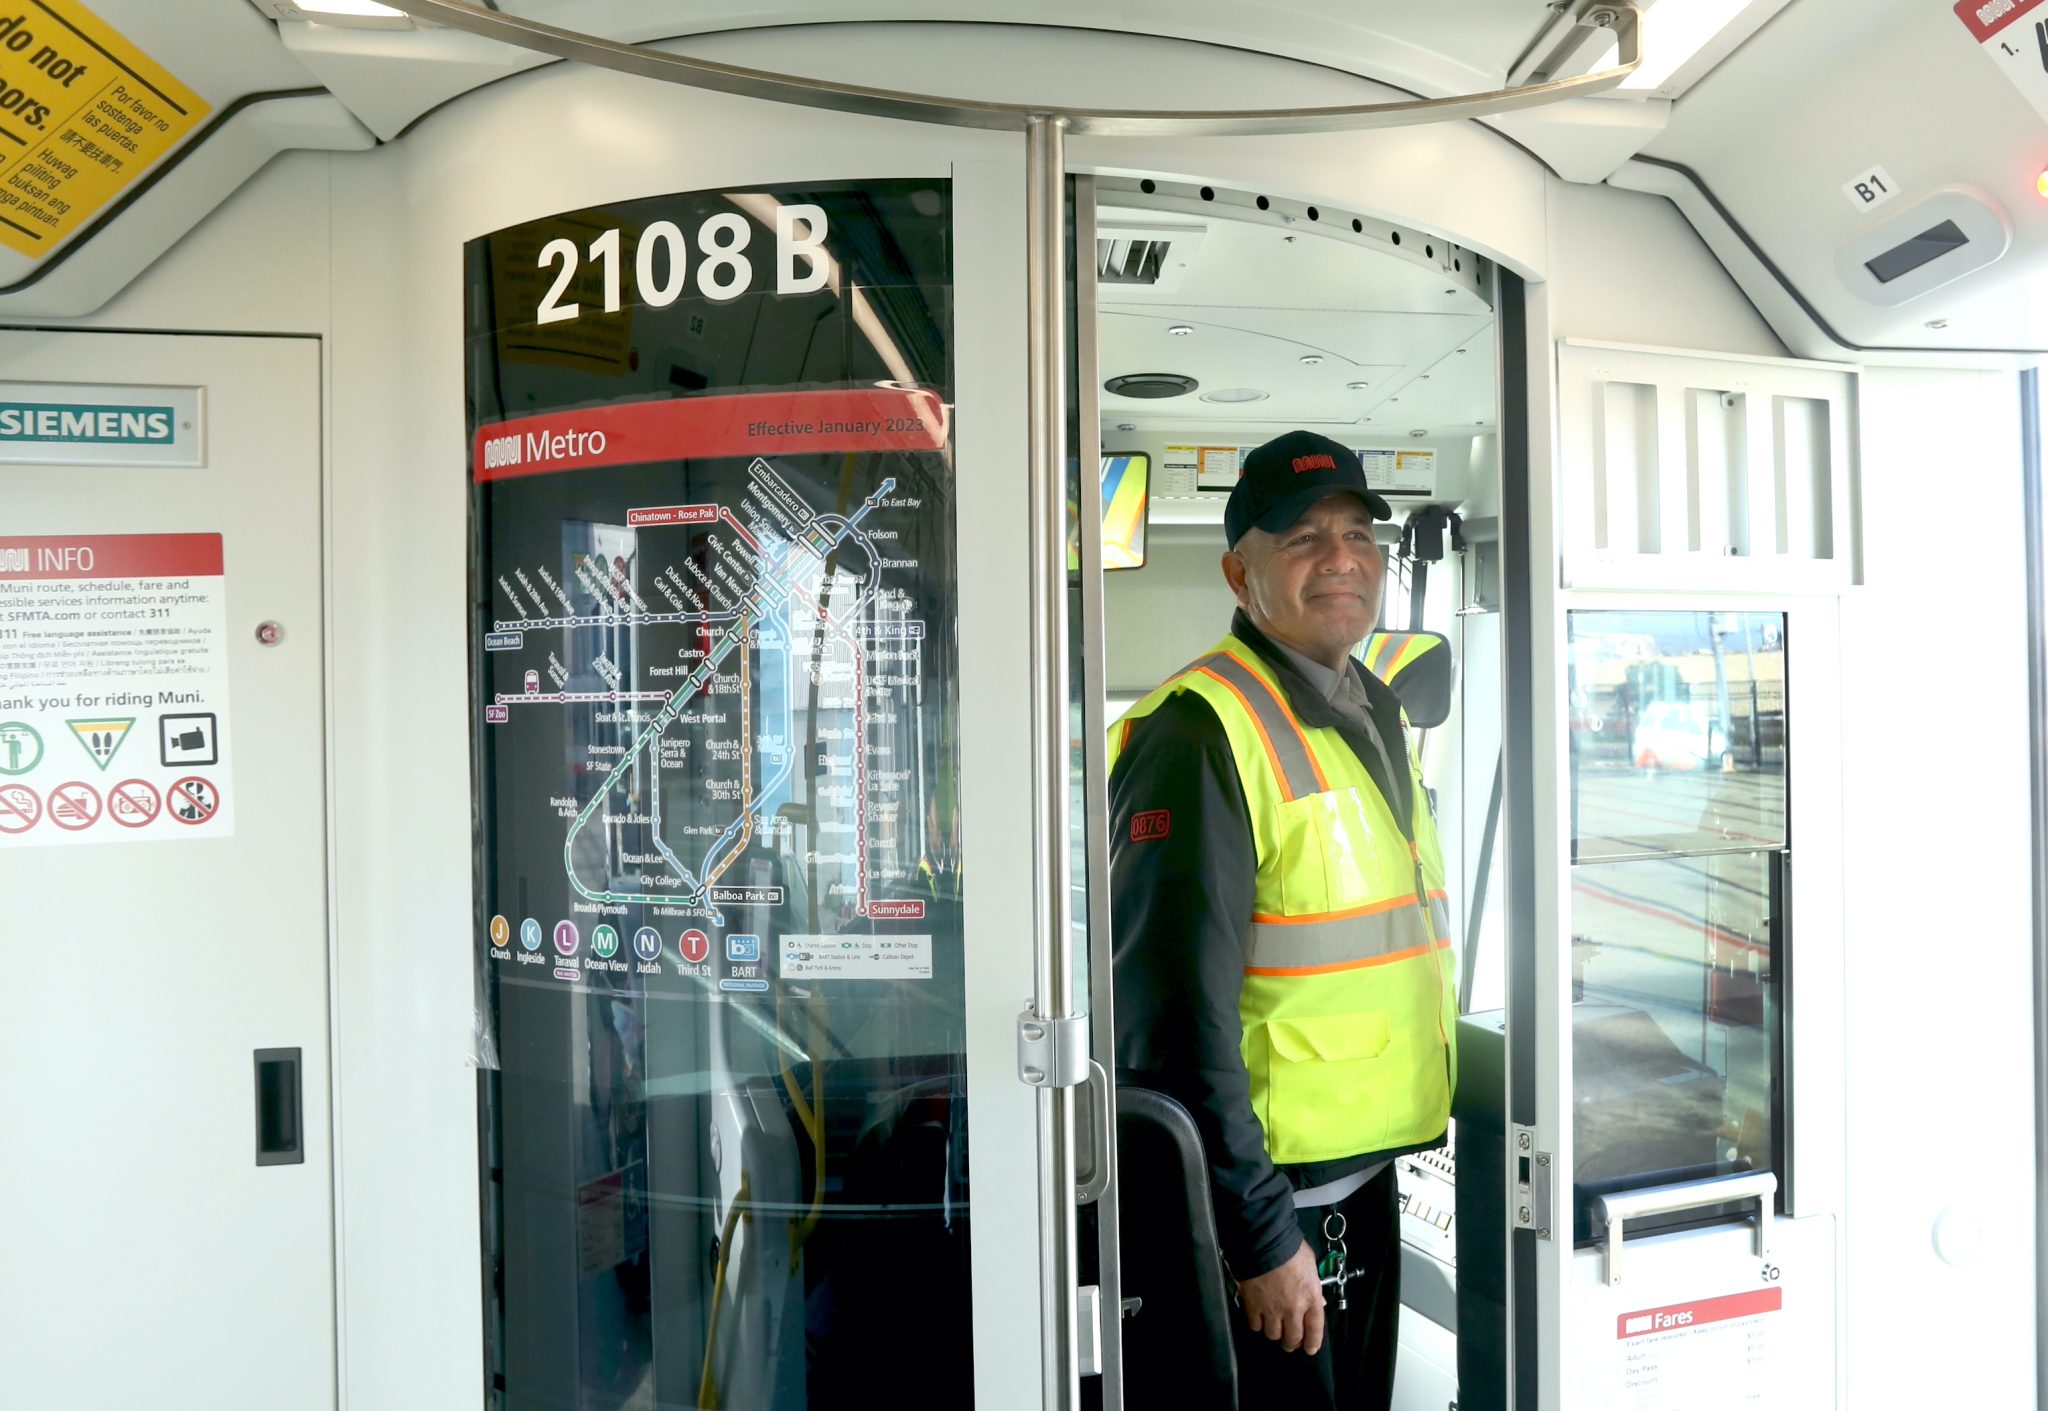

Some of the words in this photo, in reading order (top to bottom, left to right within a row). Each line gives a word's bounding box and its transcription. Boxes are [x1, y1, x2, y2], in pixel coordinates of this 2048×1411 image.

[2001, 42, 2019, 56] 1.
[28, 45, 88, 88] not
[111, 85, 133, 104] Por
[129, 99, 158, 122] favor
[153, 119, 170, 132] no
[96, 100, 143, 135] sostenga
[82, 110, 101, 128] las
[96, 123, 139, 154] puertas.
[37, 148, 78, 179] Huwag
[20, 163, 61, 190] piliting
[8, 173, 50, 202] buksan
[47, 198, 71, 215] ang
[1854, 174, 1888, 203] B1
[15, 202, 59, 228] pintuan.
[536, 212, 753, 325] 2108
[776, 203, 830, 295] B
[0, 410, 169, 438] SIEMENS
[748, 421, 813, 437] Effective
[817, 419, 881, 435] January
[885, 418, 924, 432] 2023
[527, 429, 606, 463] Metro
[753, 463, 799, 511] Embarcadero
[747, 481, 791, 529] Montgomery
[881, 498, 890, 507] To
[891, 498, 906, 507] East
[907, 498, 921, 508] Bay
[630, 512, 671, 522] Chinatown
[678, 510, 697, 519] Rose
[699, 508, 714, 518] Pak
[740, 498, 761, 522] Union
[868, 529, 898, 540] Folsom
[707, 534, 725, 555] Civic
[722, 550, 746, 575] Center
[732, 538, 757, 565] Powell
[38, 547, 94, 571] INFO
[882, 558, 918, 568] Brannan
[684, 556, 707, 584] Duboce
[704, 579, 713, 590] &
[710, 584, 732, 610] Church
[713, 562, 728, 580] Van
[725, 575, 743, 597] Ness
[1, 583, 33, 593] Muni
[37, 584, 74, 594] route,
[78, 581, 135, 592] schedule,
[139, 580, 163, 591] fare
[166, 579, 189, 590] and
[665, 565, 688, 593] Duboce
[685, 588, 693, 598] &
[690, 593, 704, 610] Noe
[897, 588, 905, 598] &
[654, 576, 668, 593] Carl
[664, 588, 671, 598] &
[669, 594, 683, 611] Cole
[38, 597, 82, 607] services
[86, 595, 156, 605] information
[159, 595, 209, 607] anytime:
[8, 611, 80, 621] SFMTA.com
[84, 612, 96, 620] or
[100, 609, 146, 619] contact
[149, 608, 170, 618] 311
[696, 626, 724, 636] Church
[855, 626, 872, 635] 4th
[885, 626, 907, 637] King
[487, 637, 503, 646] Ocean
[503, 635, 520, 645] Beach
[678, 648, 705, 657] Castro
[649, 666, 673, 676] Forest
[675, 665, 688, 675] Hill
[712, 673, 740, 683] Church
[708, 685, 715, 694] &
[715, 684, 730, 694] 18th
[730, 684, 740, 694] St
[38, 698, 70, 712] you
[76, 694, 100, 707] for
[105, 692, 153, 708] riding
[158, 690, 205, 704] Muni.
[488, 709, 495, 718] SF
[495, 709, 506, 718] Zoo
[680, 714, 701, 723] West
[701, 713, 726, 723] Portal
[588, 744, 625, 754] Stonestown
[660, 738, 690, 749] Junipero
[706, 739, 733, 749] Church
[660, 748, 679, 758] Serra
[712, 750, 730, 760] 24th
[730, 750, 740, 760] St
[586, 761, 594, 771] SF
[595, 761, 612, 771] State
[660, 759, 683, 768] Ocean
[706, 779, 733, 789] Church
[550, 796, 577, 807] Randolph
[712, 790, 730, 800] 30th
[731, 790, 741, 800] St
[564, 808, 578, 817] Arch
[627, 814, 634, 823] &
[633, 814, 650, 824] Jules
[683, 826, 698, 834] Glen
[699, 826, 713, 834] Park
[1132, 814, 1166, 836] 0876
[623, 853, 644, 863] Ocean
[651, 854, 664, 863] Lee
[640, 875, 654, 887] City
[655, 876, 682, 888] College
[713, 890, 743, 901] Balboa
[745, 890, 765, 901] Park
[574, 902, 592, 912] Broad
[597, 904, 628, 916] Plymouth
[653, 907, 660, 915] To
[692, 908, 704, 916] SFO
[872, 905, 920, 916] Sunnydale
[495, 923, 503, 939] J
[526, 926, 536, 943] K
[562, 929, 571, 946] L
[597, 932, 613, 949] M
[640, 935, 655, 952] N
[687, 937, 700, 954] T
[490, 947, 511, 960] Church
[516, 951, 545, 965] Ingleside
[554, 955, 579, 968] Taraval
[584, 958, 608, 970] Ocean
[608, 960, 628, 972] View
[636, 962, 661, 974] Judah
[677, 964, 699, 976] Third
[701, 964, 712, 977] St
[731, 966, 757, 977] BART
[1655, 1310, 1693, 1329] Fares
